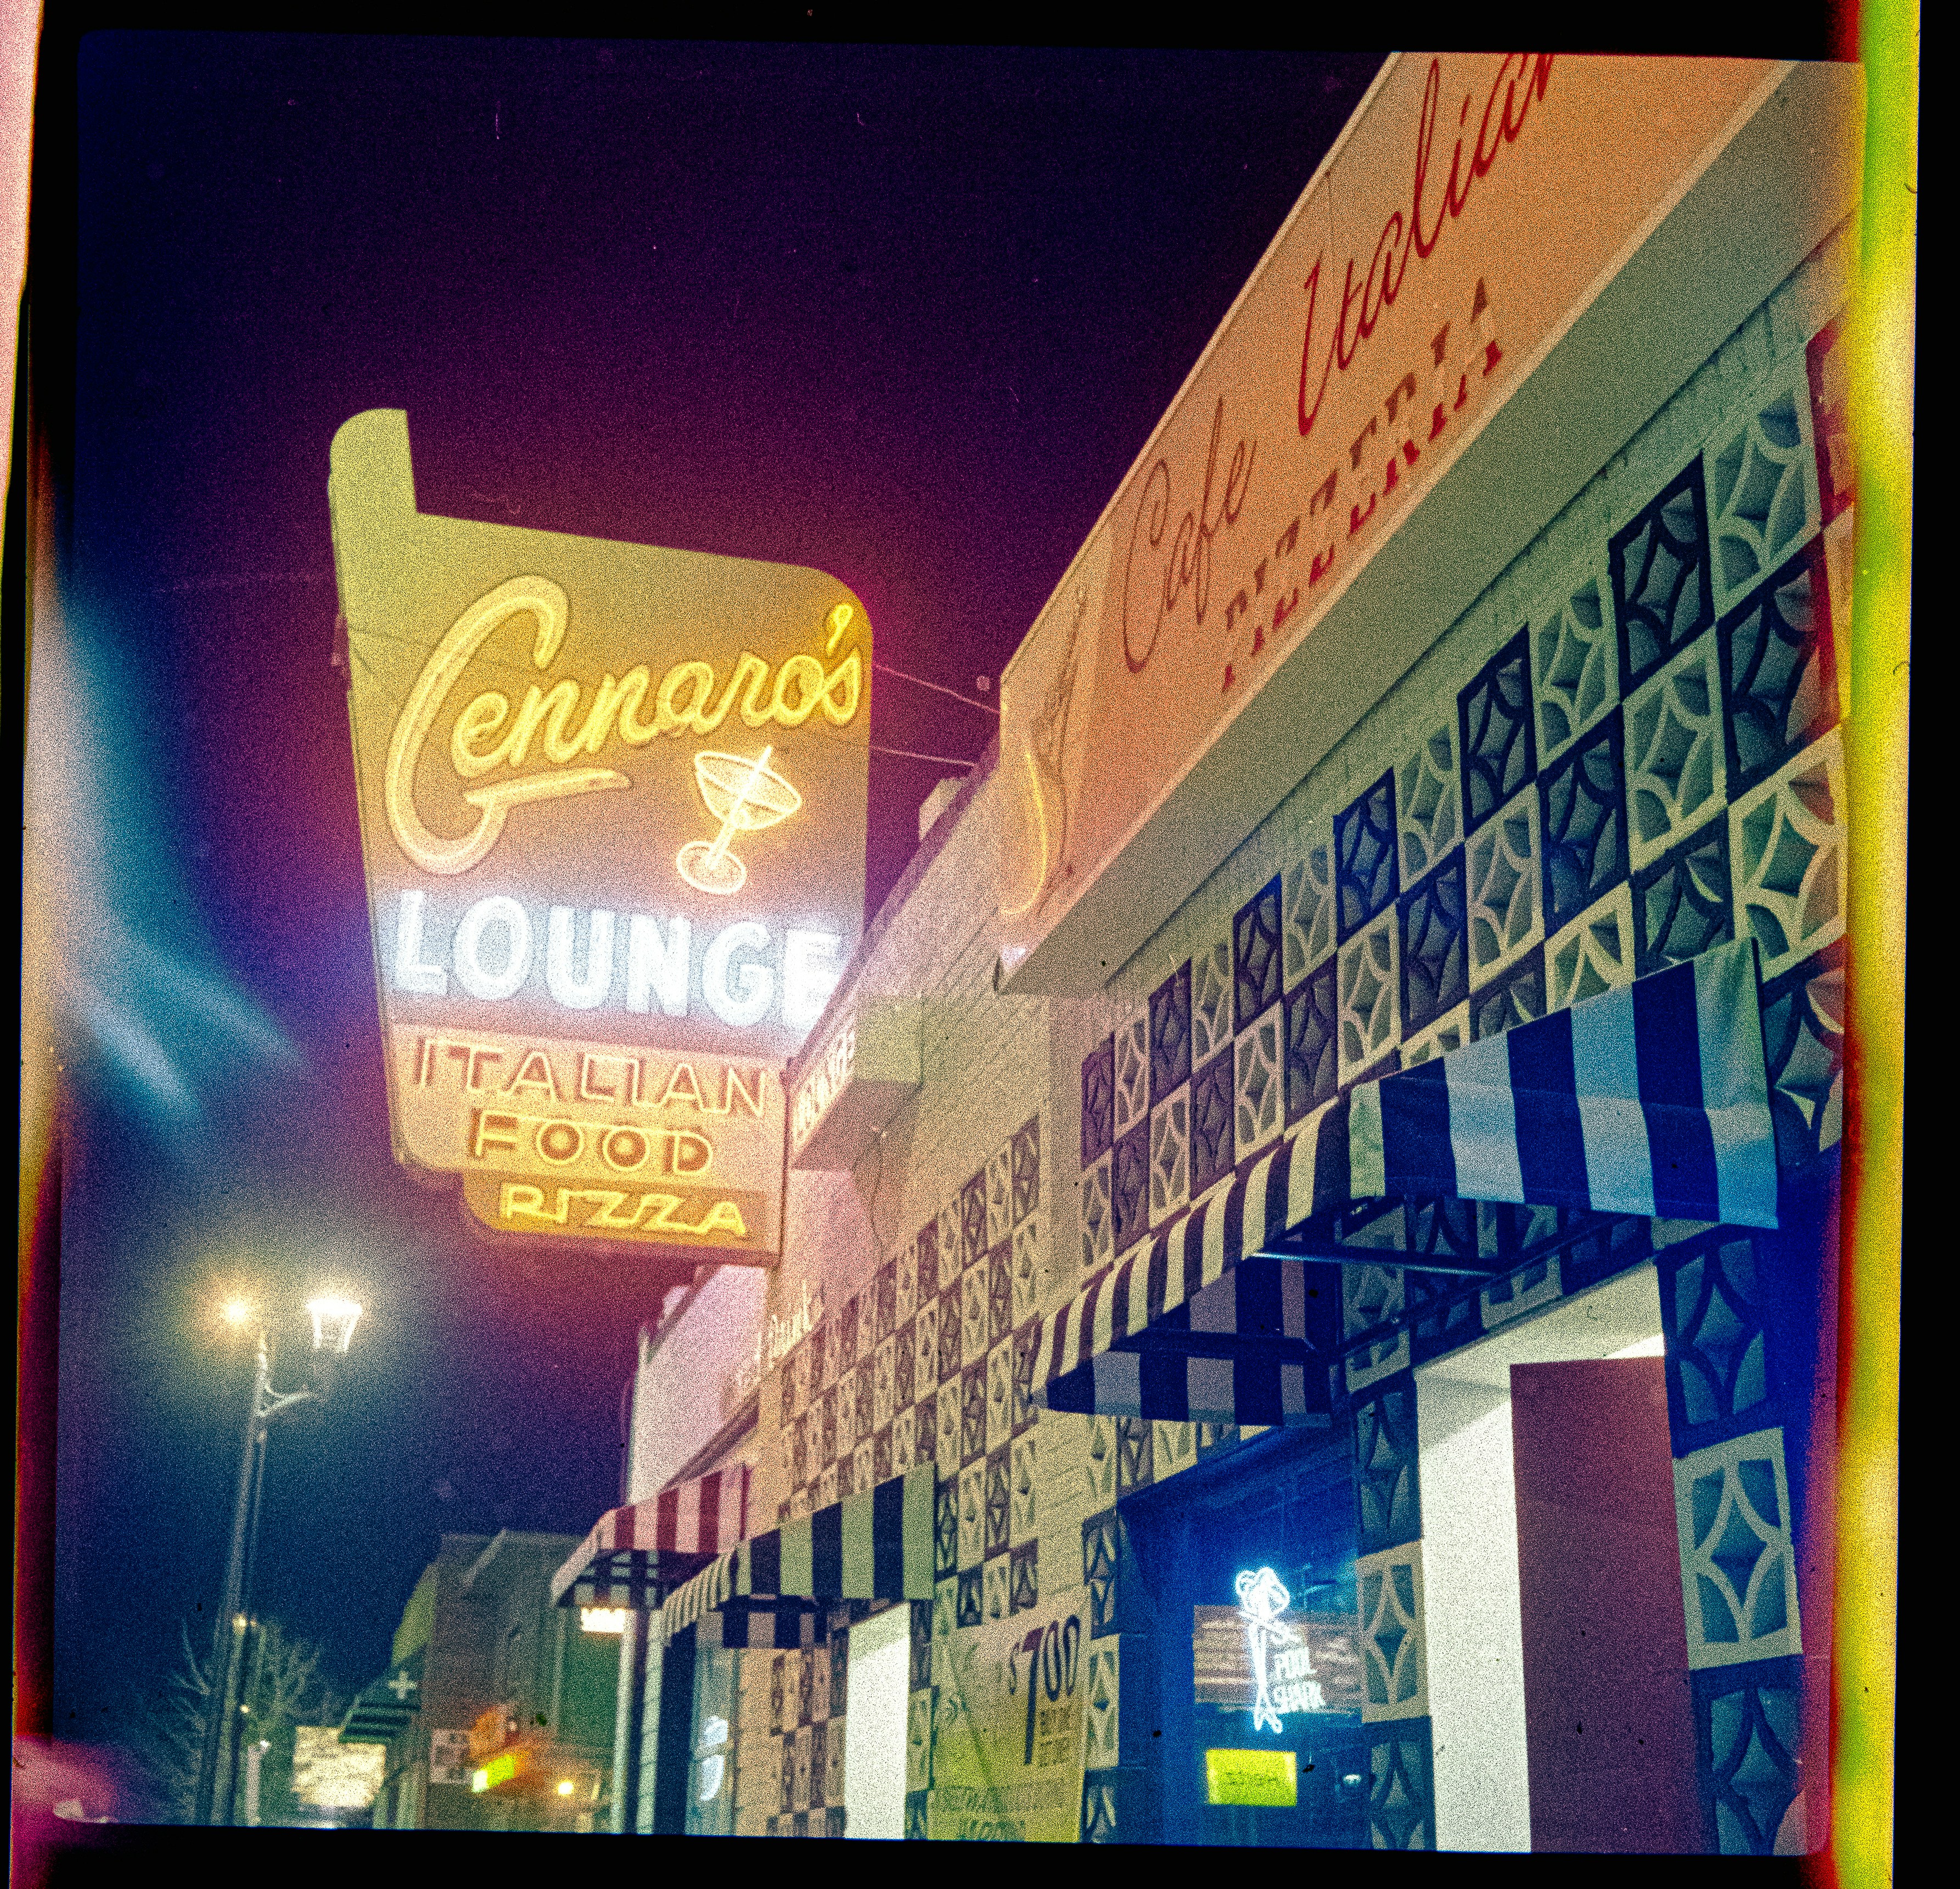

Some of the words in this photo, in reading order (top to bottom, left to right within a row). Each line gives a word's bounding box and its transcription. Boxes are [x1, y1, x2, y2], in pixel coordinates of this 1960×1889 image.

[1122, 394, 1258, 674] Cafe
[385, 574, 862, 874] Gennaro's
[391, 889, 844, 1033] LOUNGE
[414, 1037, 768, 1118] ITALIAN
[469, 1107, 714, 1177] FOOD
[501, 1182, 747, 1236] PIZZA
